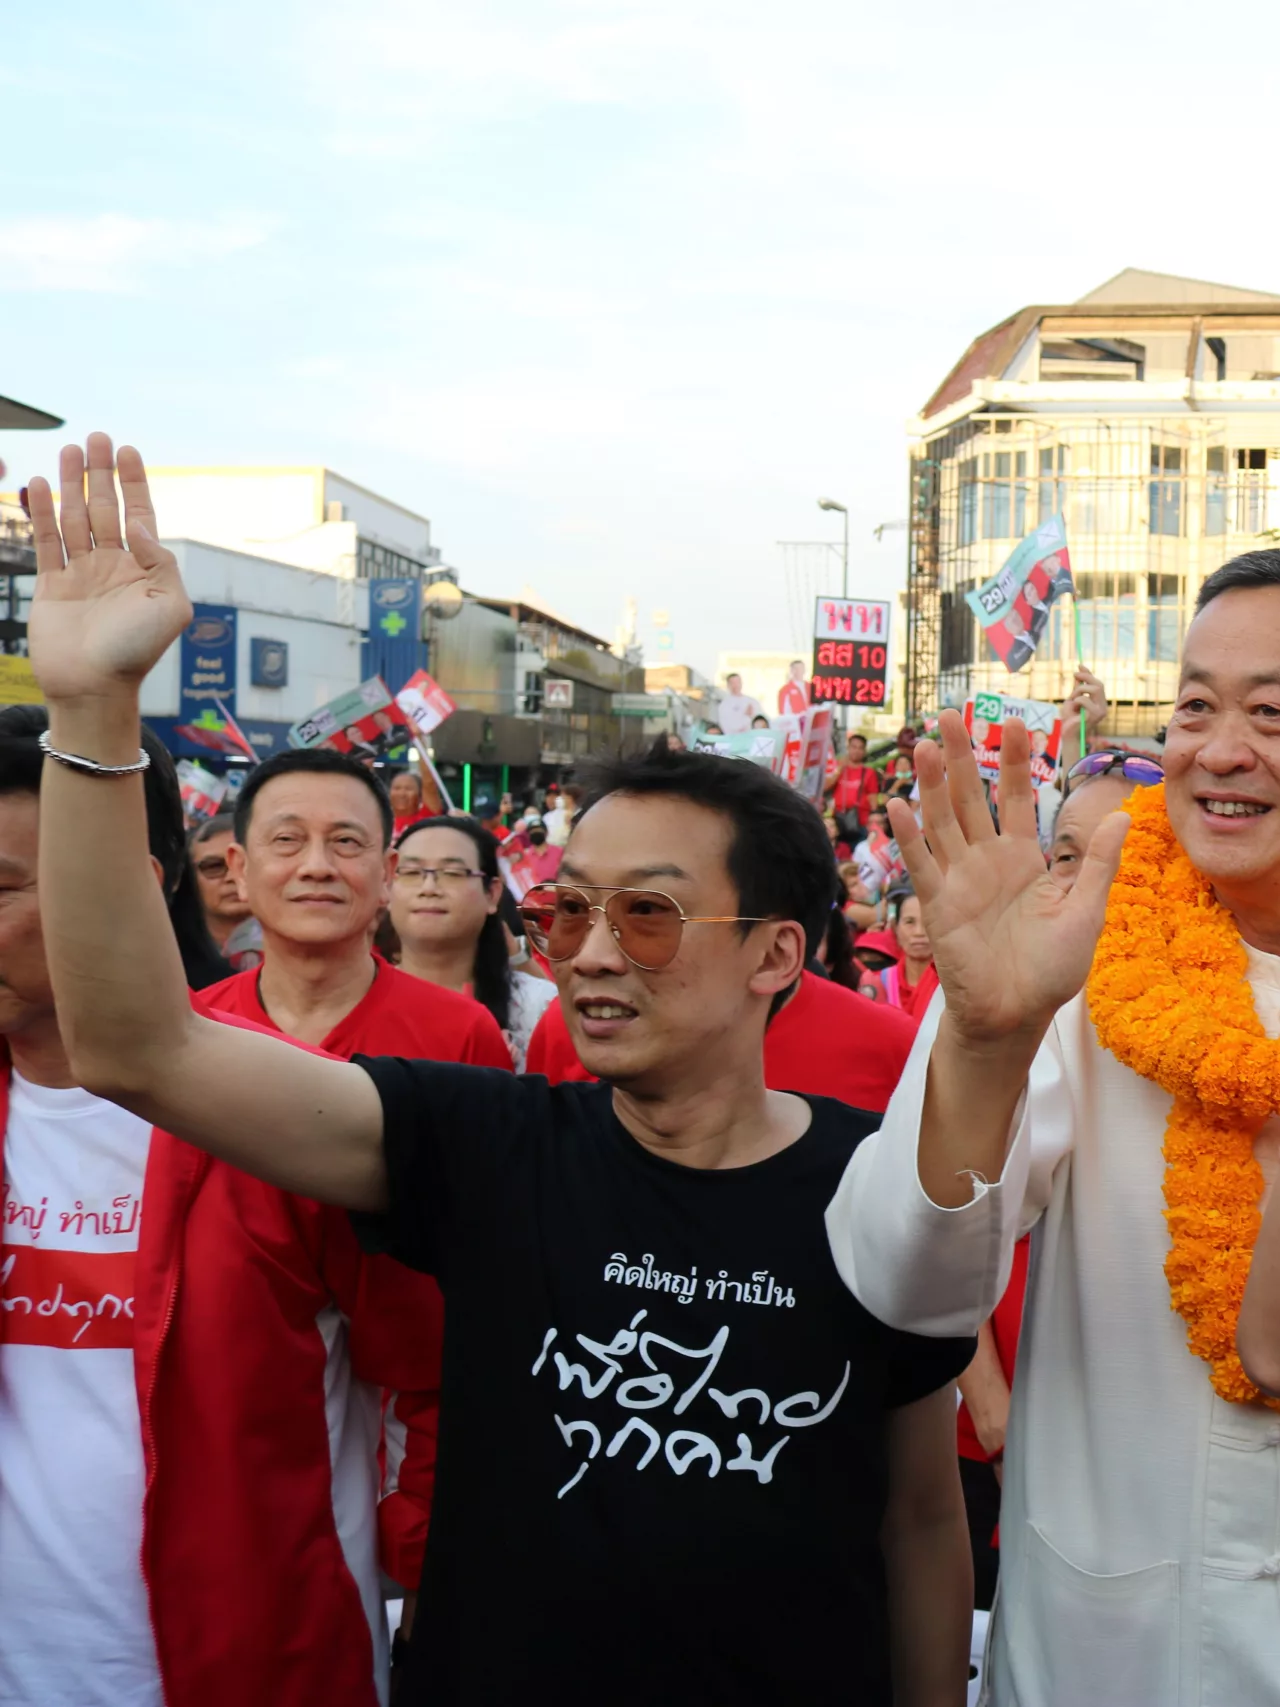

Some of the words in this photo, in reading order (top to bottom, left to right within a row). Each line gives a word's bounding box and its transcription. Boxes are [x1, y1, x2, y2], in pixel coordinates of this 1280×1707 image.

[823, 601, 882, 634] พท
[858, 645, 886, 669] 10
[855, 678, 884, 702] 29
[976, 697, 998, 718] 29
[59, 1194, 142, 1236] ทำเป็
[604, 1252, 698, 1304] คิดใหญ่
[705, 1270, 796, 1308] ทำเป็น
[531, 1309, 851, 1427] เพื่อไทย
[554, 1413, 790, 1499] ทุกคน
